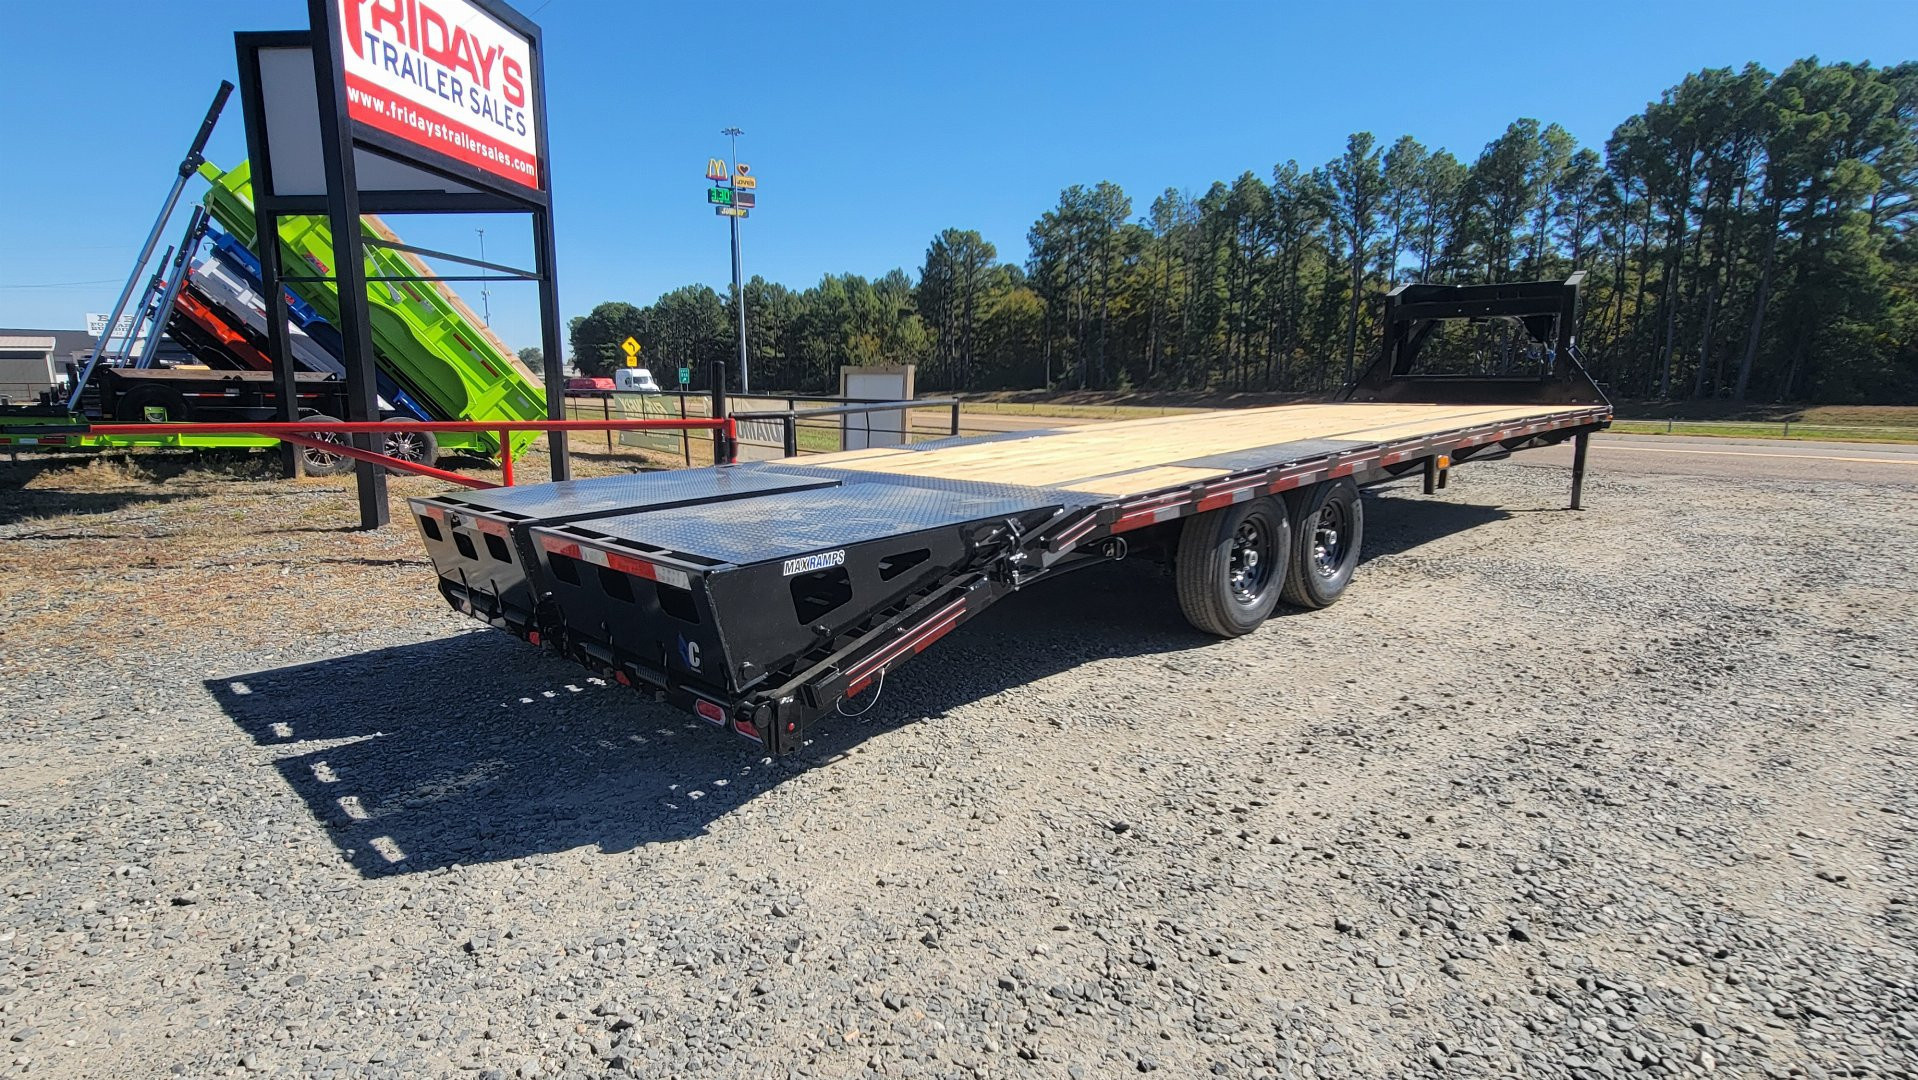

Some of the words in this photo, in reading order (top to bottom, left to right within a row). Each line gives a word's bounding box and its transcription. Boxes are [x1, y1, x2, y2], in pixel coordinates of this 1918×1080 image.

[347, 86, 535, 176] www.fridaystrailersales.com
[364, 31, 464, 108] TRAILER
[469, 87, 526, 137] SALES
